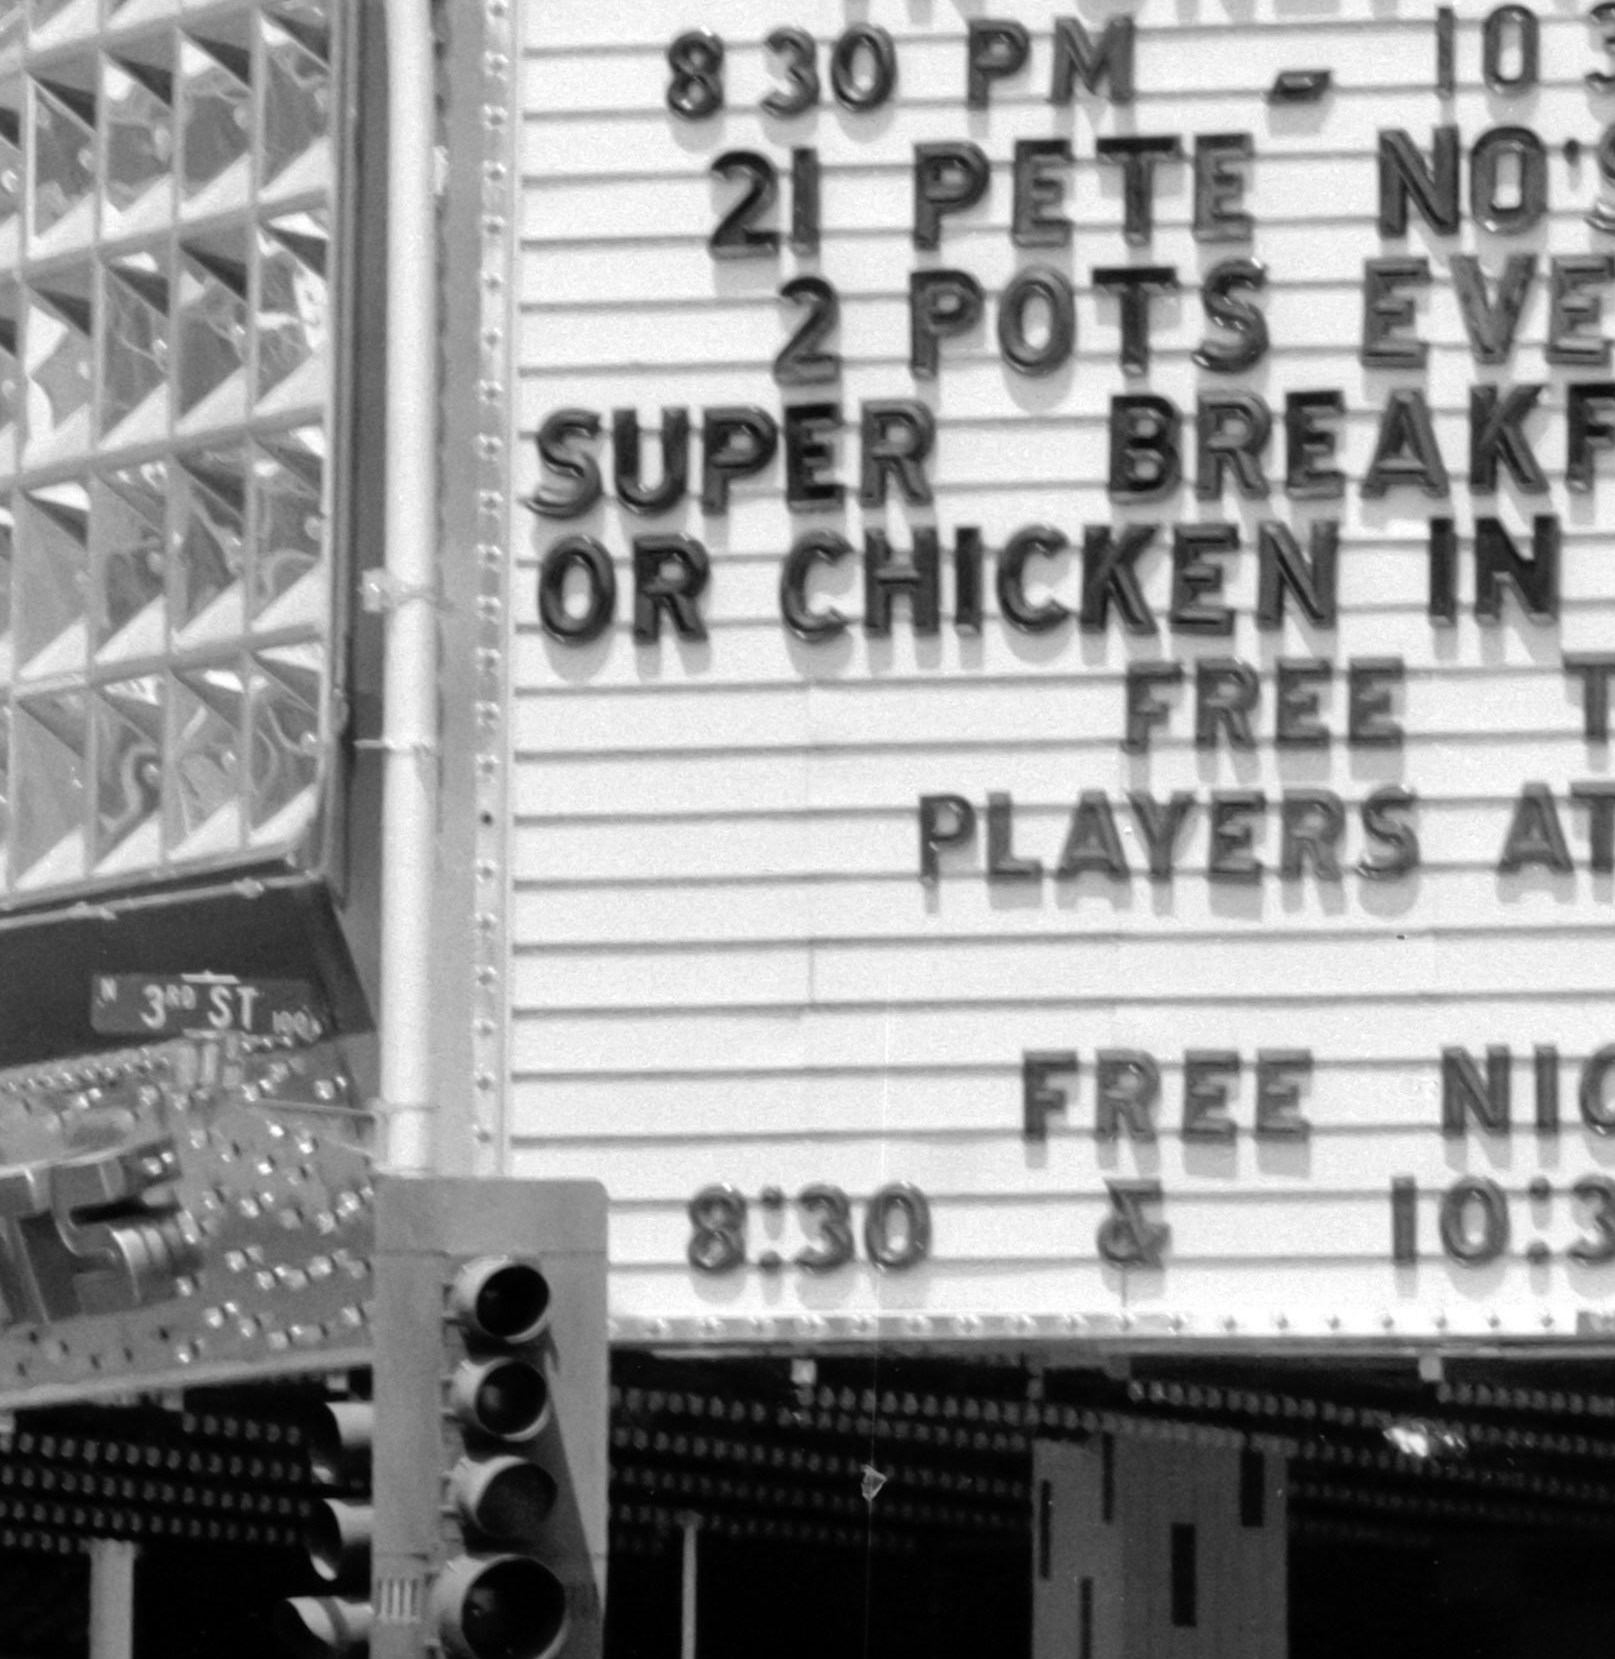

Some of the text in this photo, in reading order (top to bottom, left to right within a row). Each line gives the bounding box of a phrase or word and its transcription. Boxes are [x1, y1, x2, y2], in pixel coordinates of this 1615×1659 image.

[964, 13, 1140, 113] PM
[1263, 68, 1334, 108] -
[705, 144, 825, 263] 21
[909, 131, 1257, 255] PETE
[770, 272, 846, 390] 2
[905, 256, 1273, 382] POTS
[524, 398, 939, 526] SUPER
[536, 531, 713, 651] OR
[777, 518, 1345, 649] CHICKEN
[1424, 511, 1566, 630] IN
[1117, 656, 1408, 758] FREE
[915, 790, 1423, 888] PLAYERS
[139, 984, 197, 1030] 3RD
[207, 985, 260, 1031] ST
[1019, 1052, 1317, 1147] FREE
[685, 1188, 932, 1279] 8:30
[1096, 1182, 1170, 1271] &
